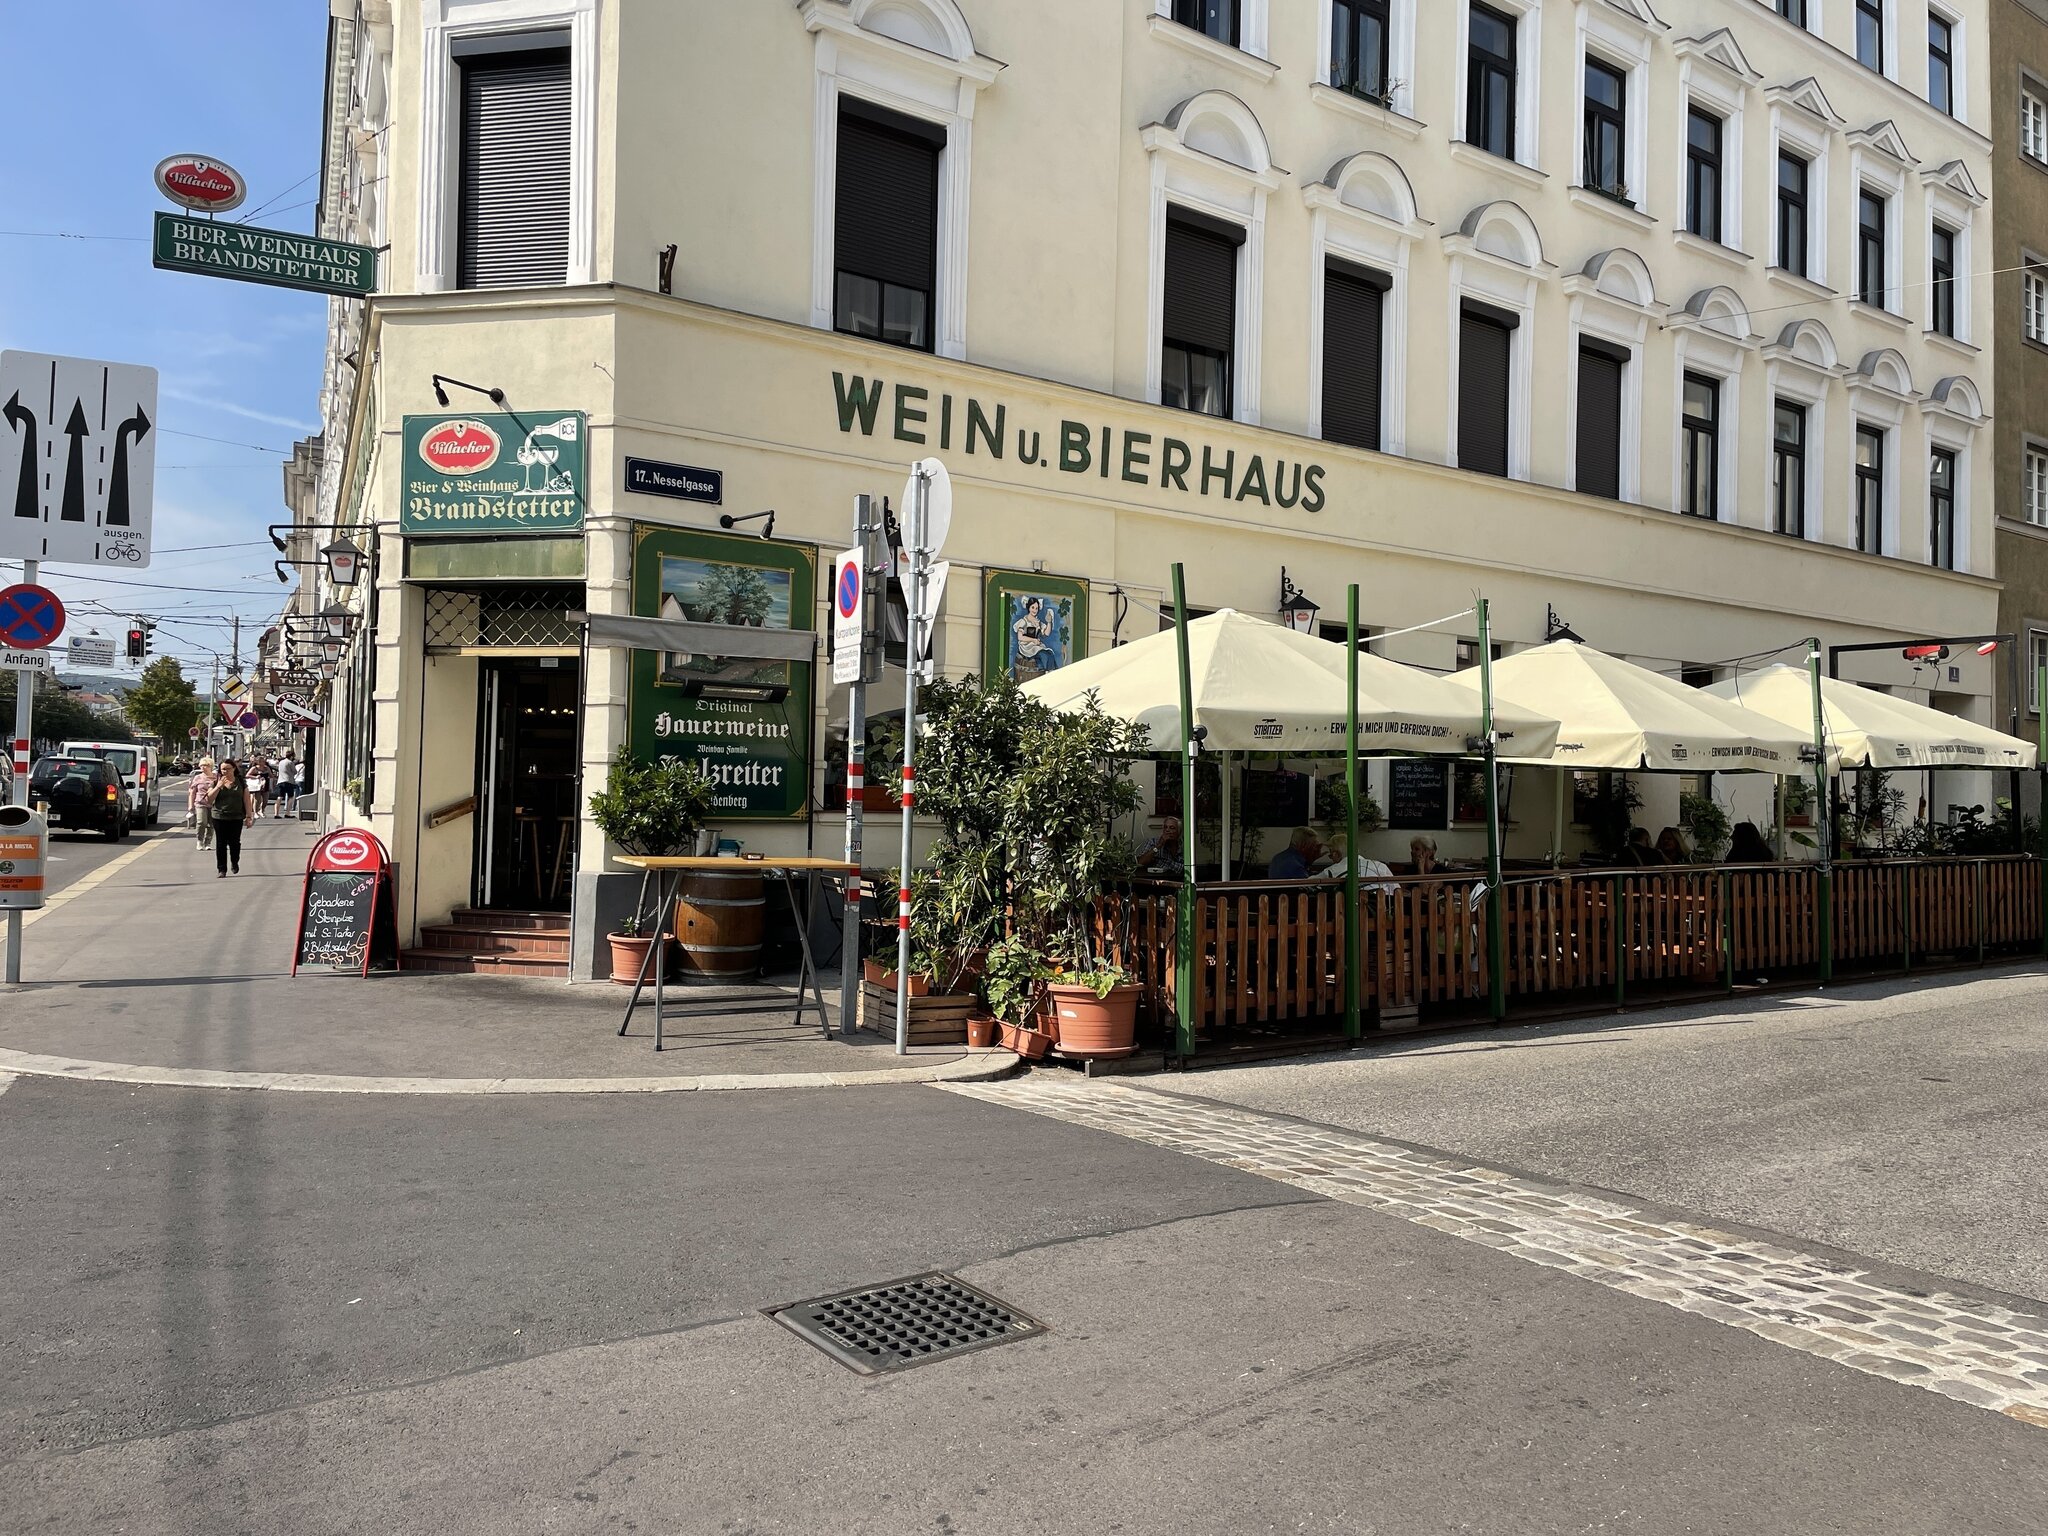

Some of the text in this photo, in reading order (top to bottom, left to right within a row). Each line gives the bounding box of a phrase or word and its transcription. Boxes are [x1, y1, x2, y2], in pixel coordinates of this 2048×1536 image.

[169, 172, 232, 192] Villacher
[172, 222, 361, 267] BIER-WEINHAUS
[174, 242, 359, 286] BRANDSTETTER
[429, 440, 491, 455] Villacher
[832, 371, 1326, 513] WEIN u. BIERHAUS
[410, 479, 519, 494] Bier & Weinhaus
[653, 472, 714, 493] Nesselgasse
[410, 496, 576, 521] Brandstetter
[103, 529, 145, 540] ausgen.
[4, 653, 44, 668] Anfang
[695, 700, 753, 713] Original
[655, 711, 789, 738] Hauerweine
[1254, 724, 1283, 736] STIBITZER
[1330, 721, 1449, 738] ERWH MICH UND ERFRISCH DICH!
[697, 744, 748, 755] Weinbau Familie
[350, 877, 374, 897] €13,90
[309, 892, 355, 917] Gebackene
[315, 908, 354, 927] Steinpilze
[304, 926, 317, 938] mit
[310, 940, 351, 953] Blattsalat
